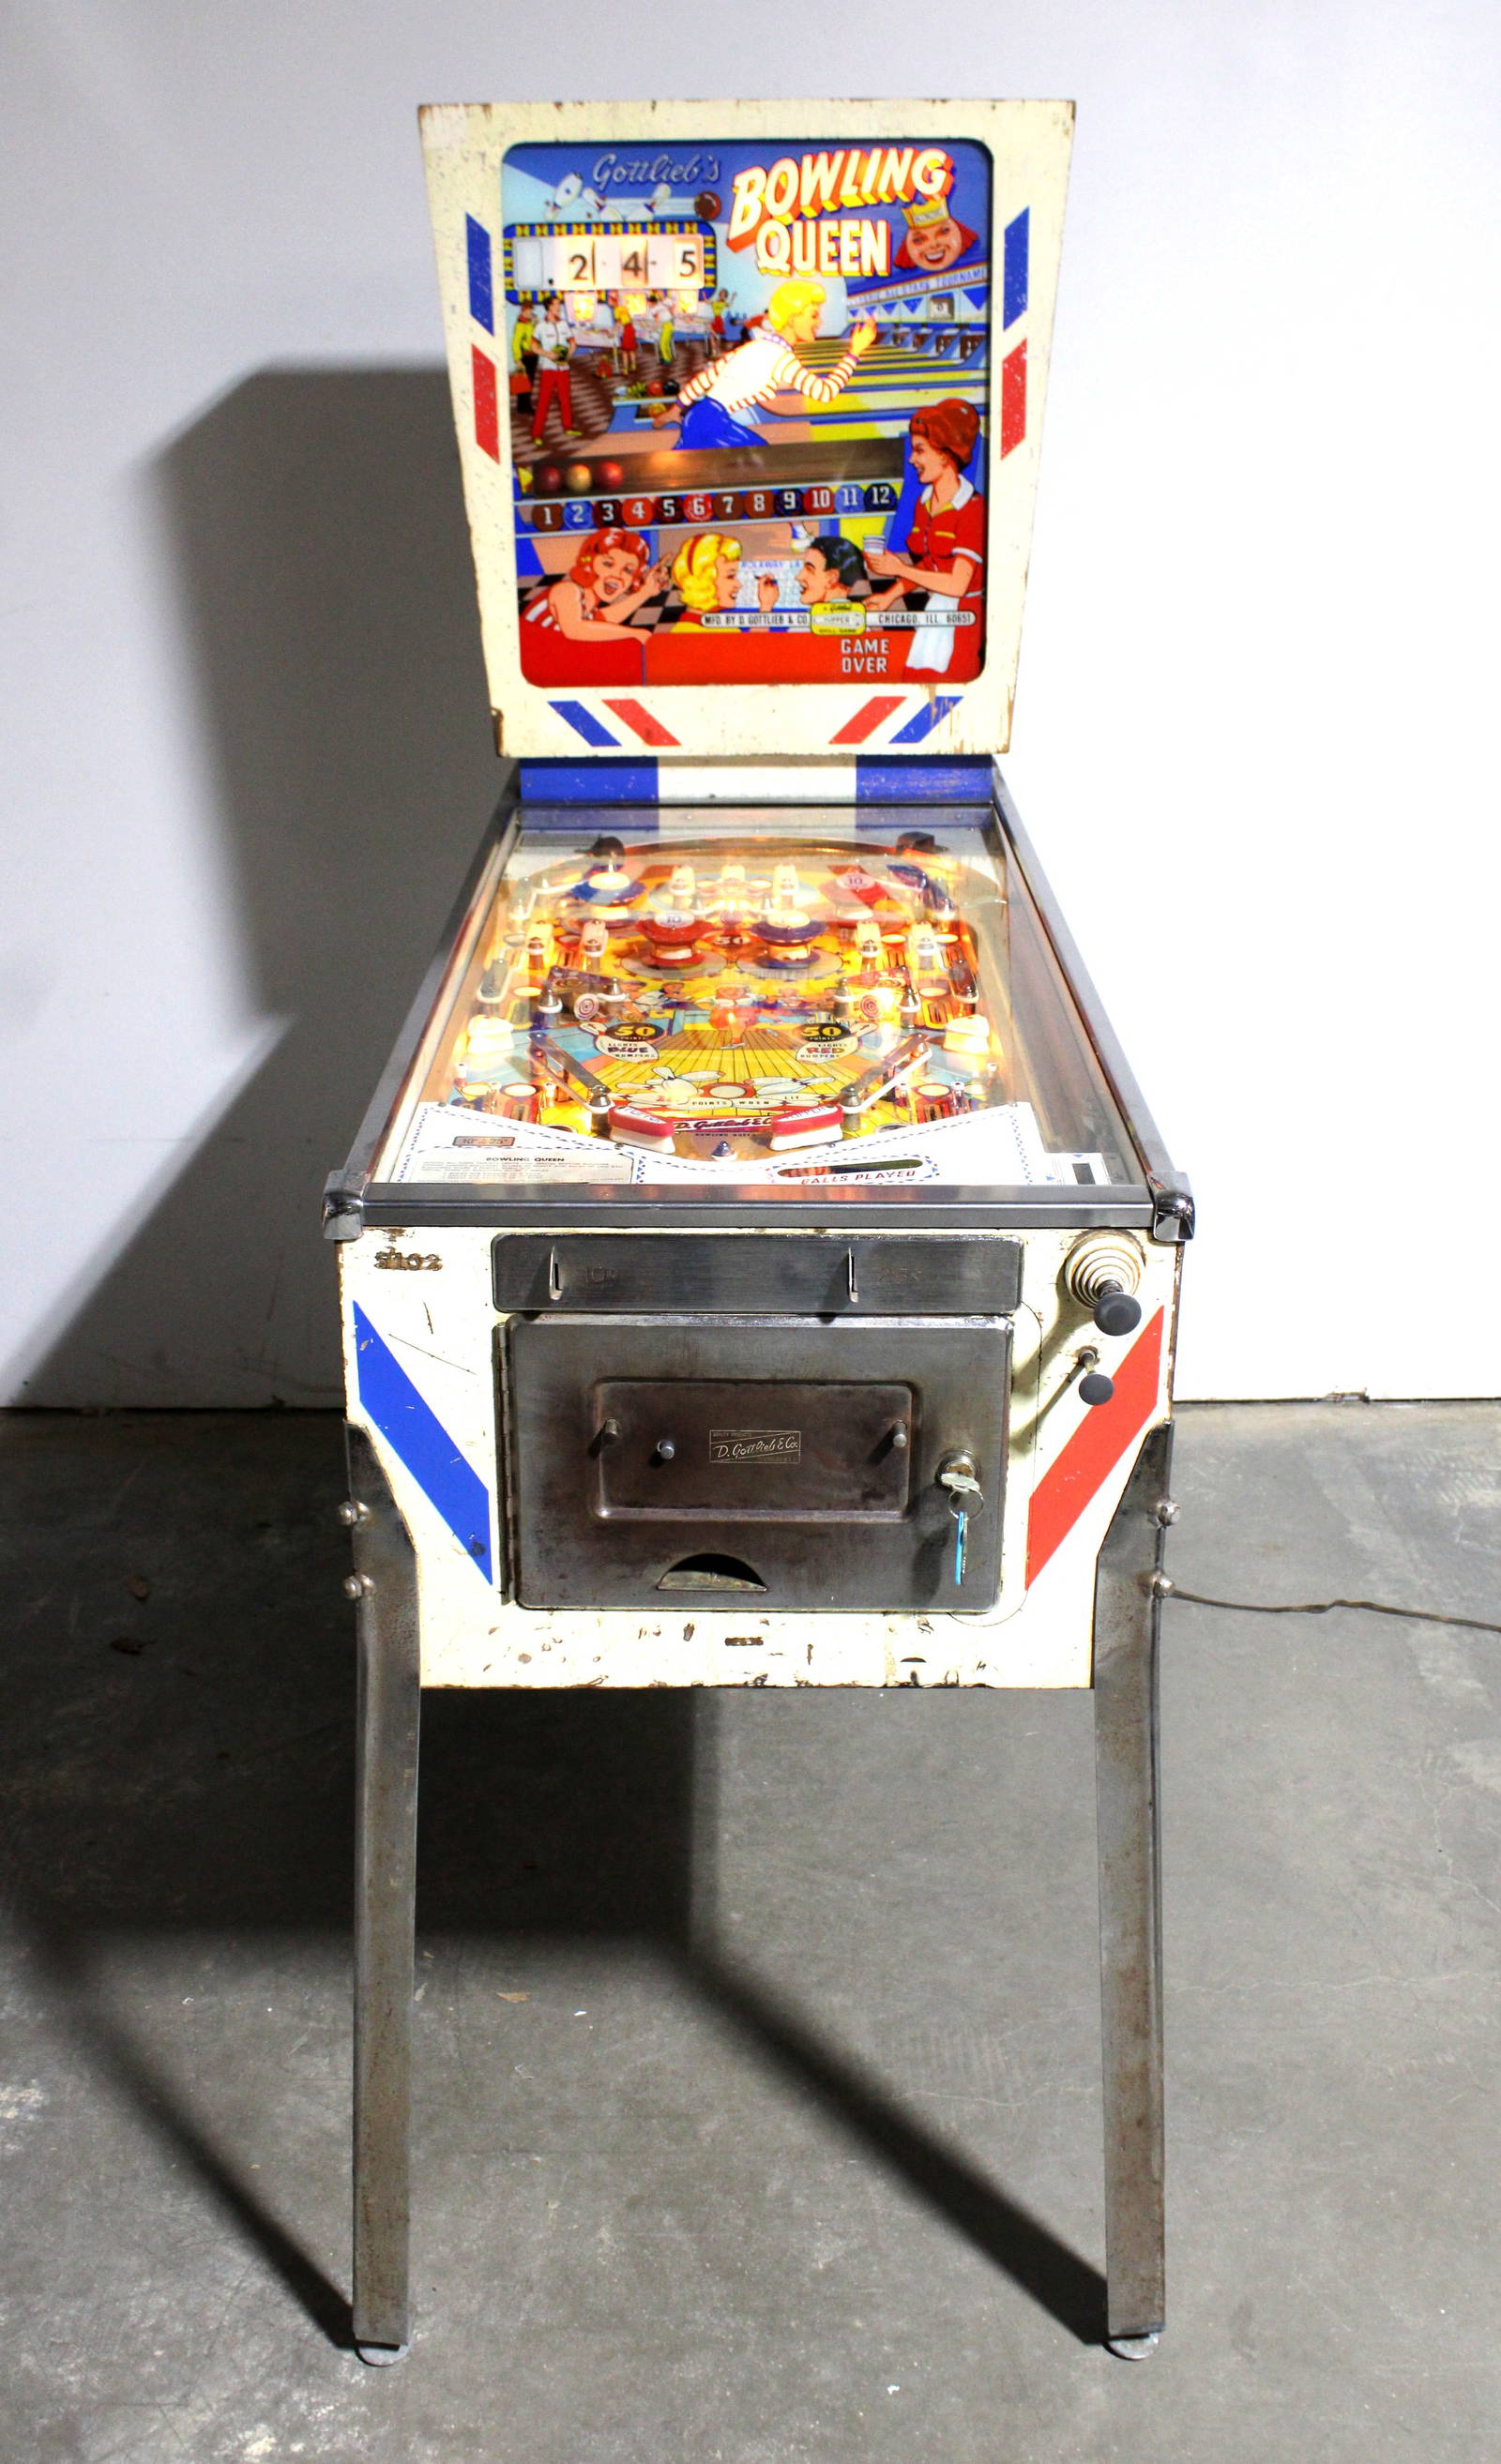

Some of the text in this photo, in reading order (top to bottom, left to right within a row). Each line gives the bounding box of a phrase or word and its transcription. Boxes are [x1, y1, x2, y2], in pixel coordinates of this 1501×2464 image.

[593, 152, 721, 191] Gottlieb's
[726, 146, 955, 253] BOWLING
[756, 219, 890, 278] QUEEN
[569, 249, 698, 280] 2 4 5
[543, 485, 890, 525] 1 2 3 4 5 6 7 8 9 10 11 12
[748, 614, 784, 625] GOTTLIEB
[841, 638, 890, 655] GAME
[841, 657, 887, 673] OVER
[614, 1024, 656, 1037] 50
[801, 1025, 842, 1037] 50
[800, 1170, 917, 1186] BALLS PLAYED
[713, 1435, 798, 1459] D. Gottlieb & Co.
